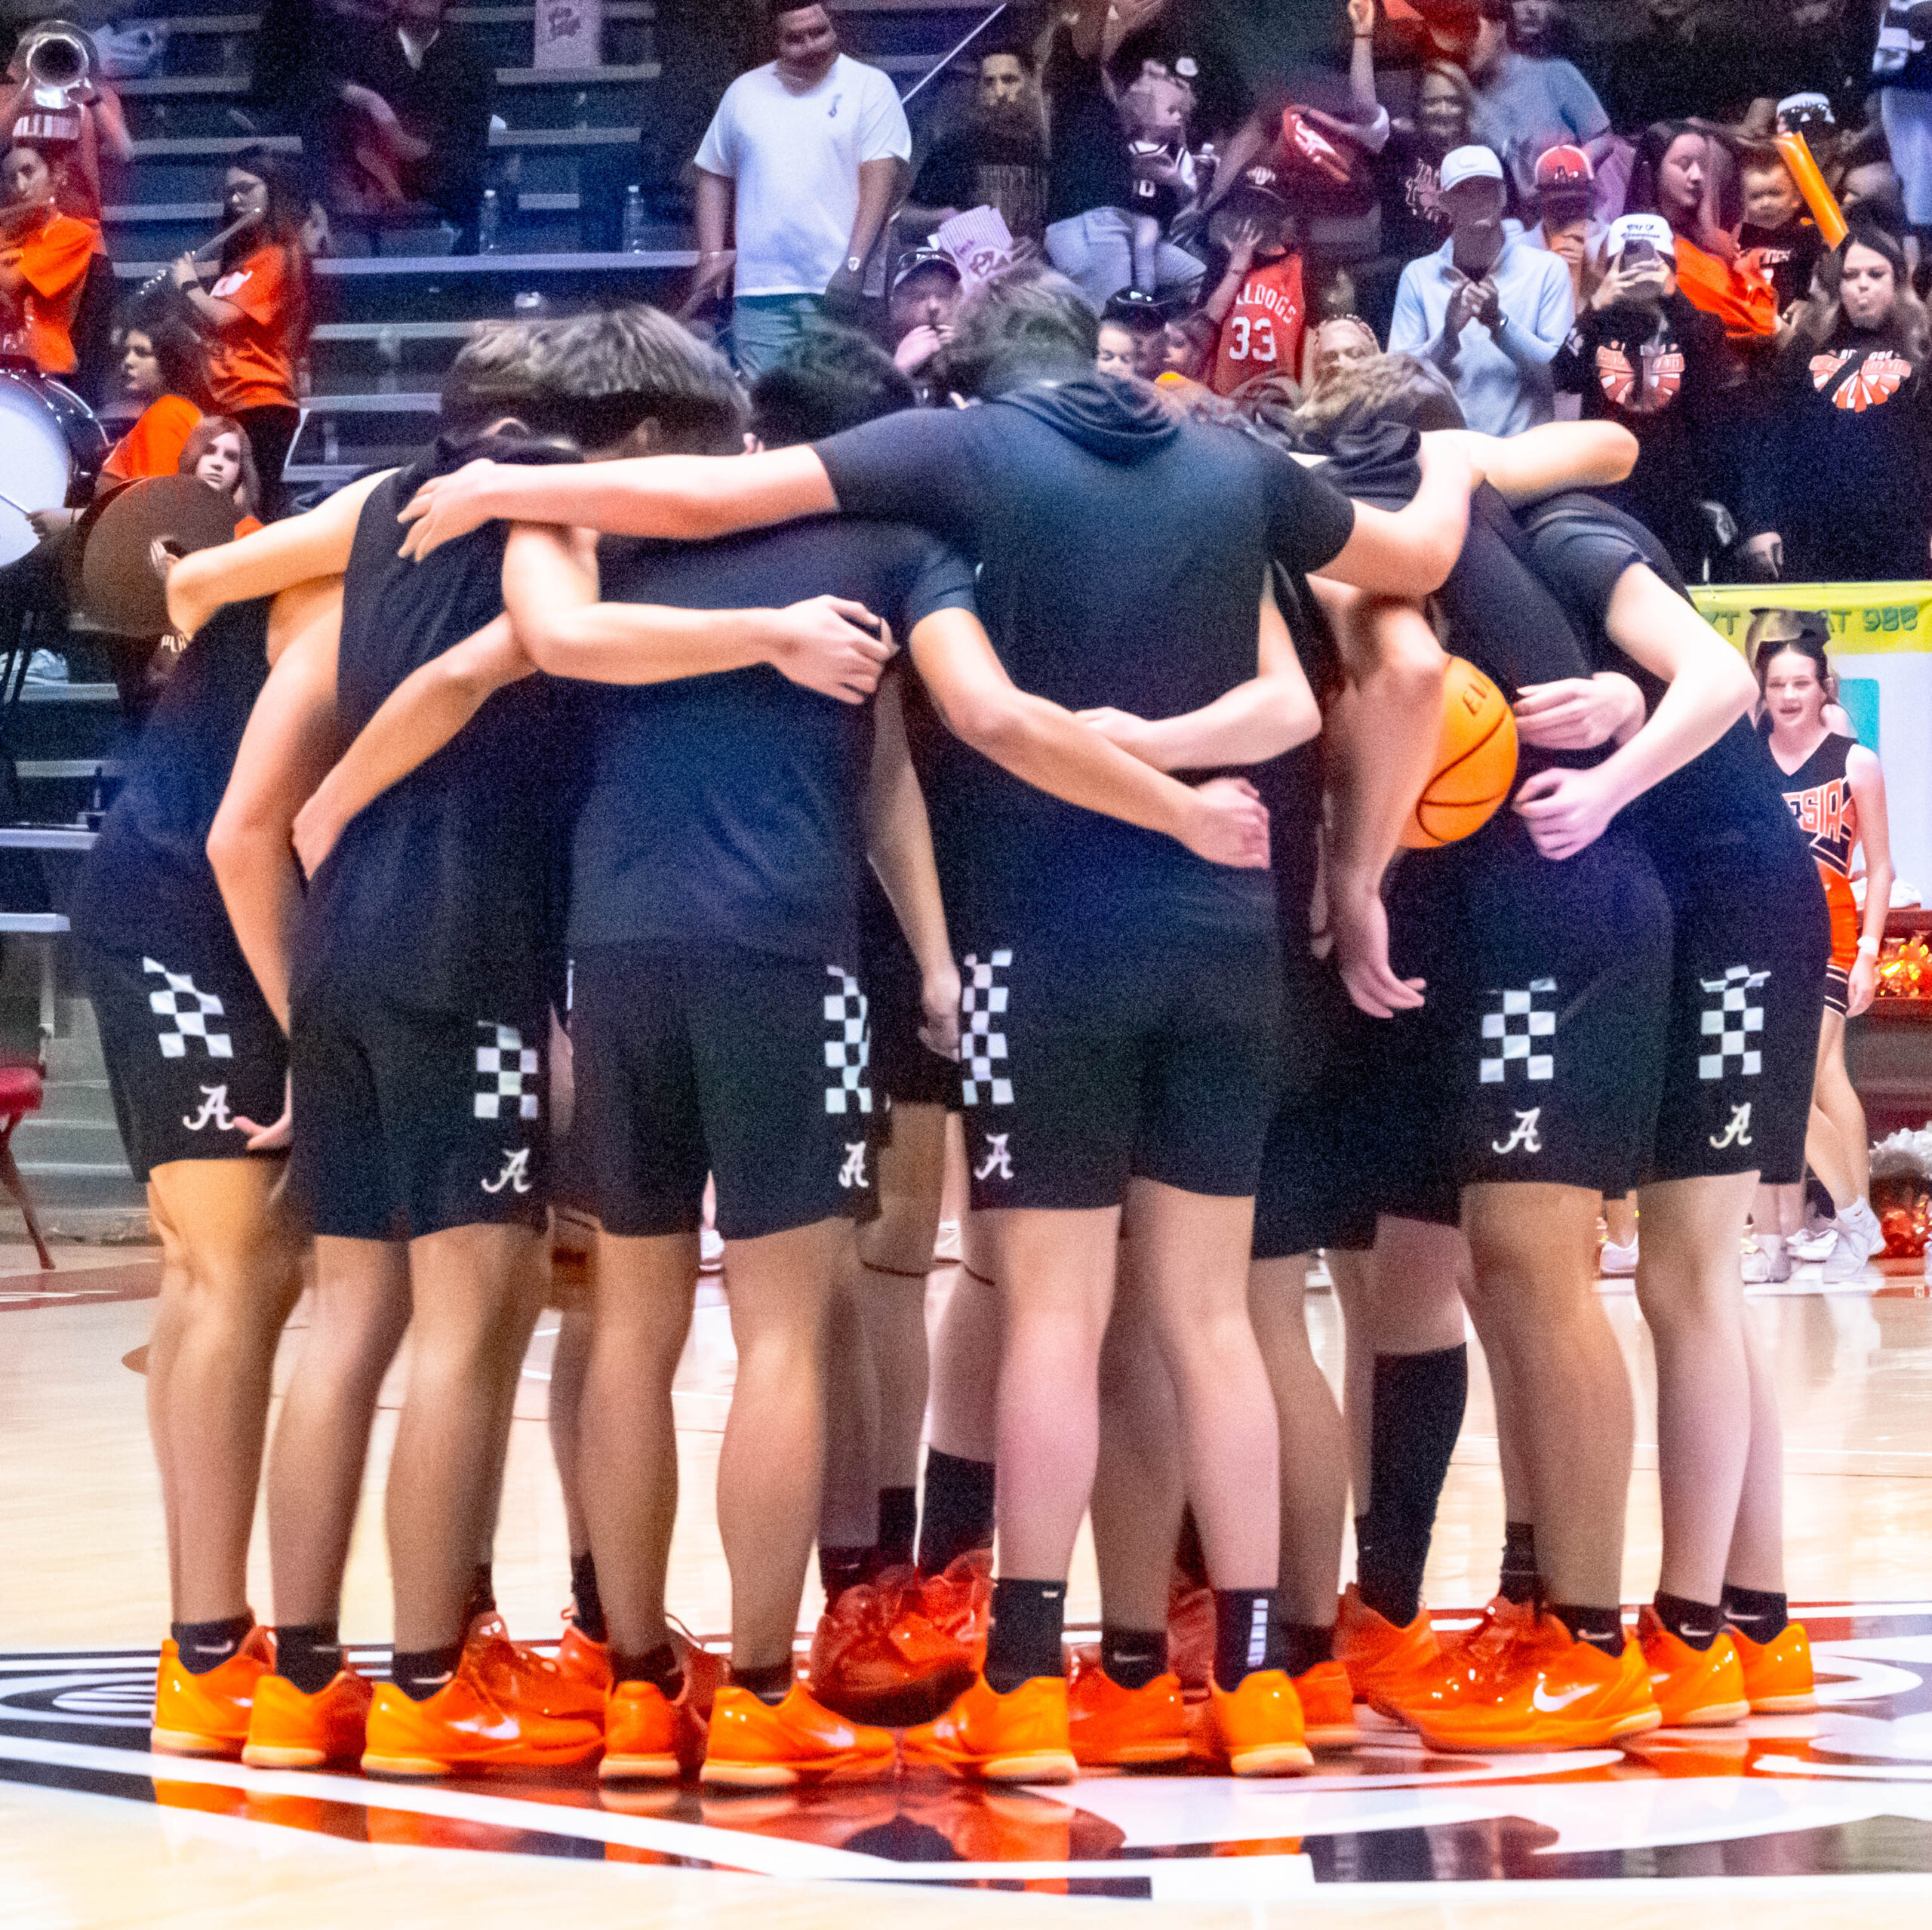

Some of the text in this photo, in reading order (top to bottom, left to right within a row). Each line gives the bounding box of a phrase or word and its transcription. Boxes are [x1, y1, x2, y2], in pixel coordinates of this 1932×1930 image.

[1229, 316, 1277, 362] 33
[1863, 606, 1918, 632] 988
[183, 1084, 235, 1131] A
[1491, 1107, 1542, 1153] A
[1709, 1102, 1752, 1149] A
[481, 1148, 533, 1193] A
[838, 1140, 869, 1188] A
[974, 1133, 1015, 1180] A
